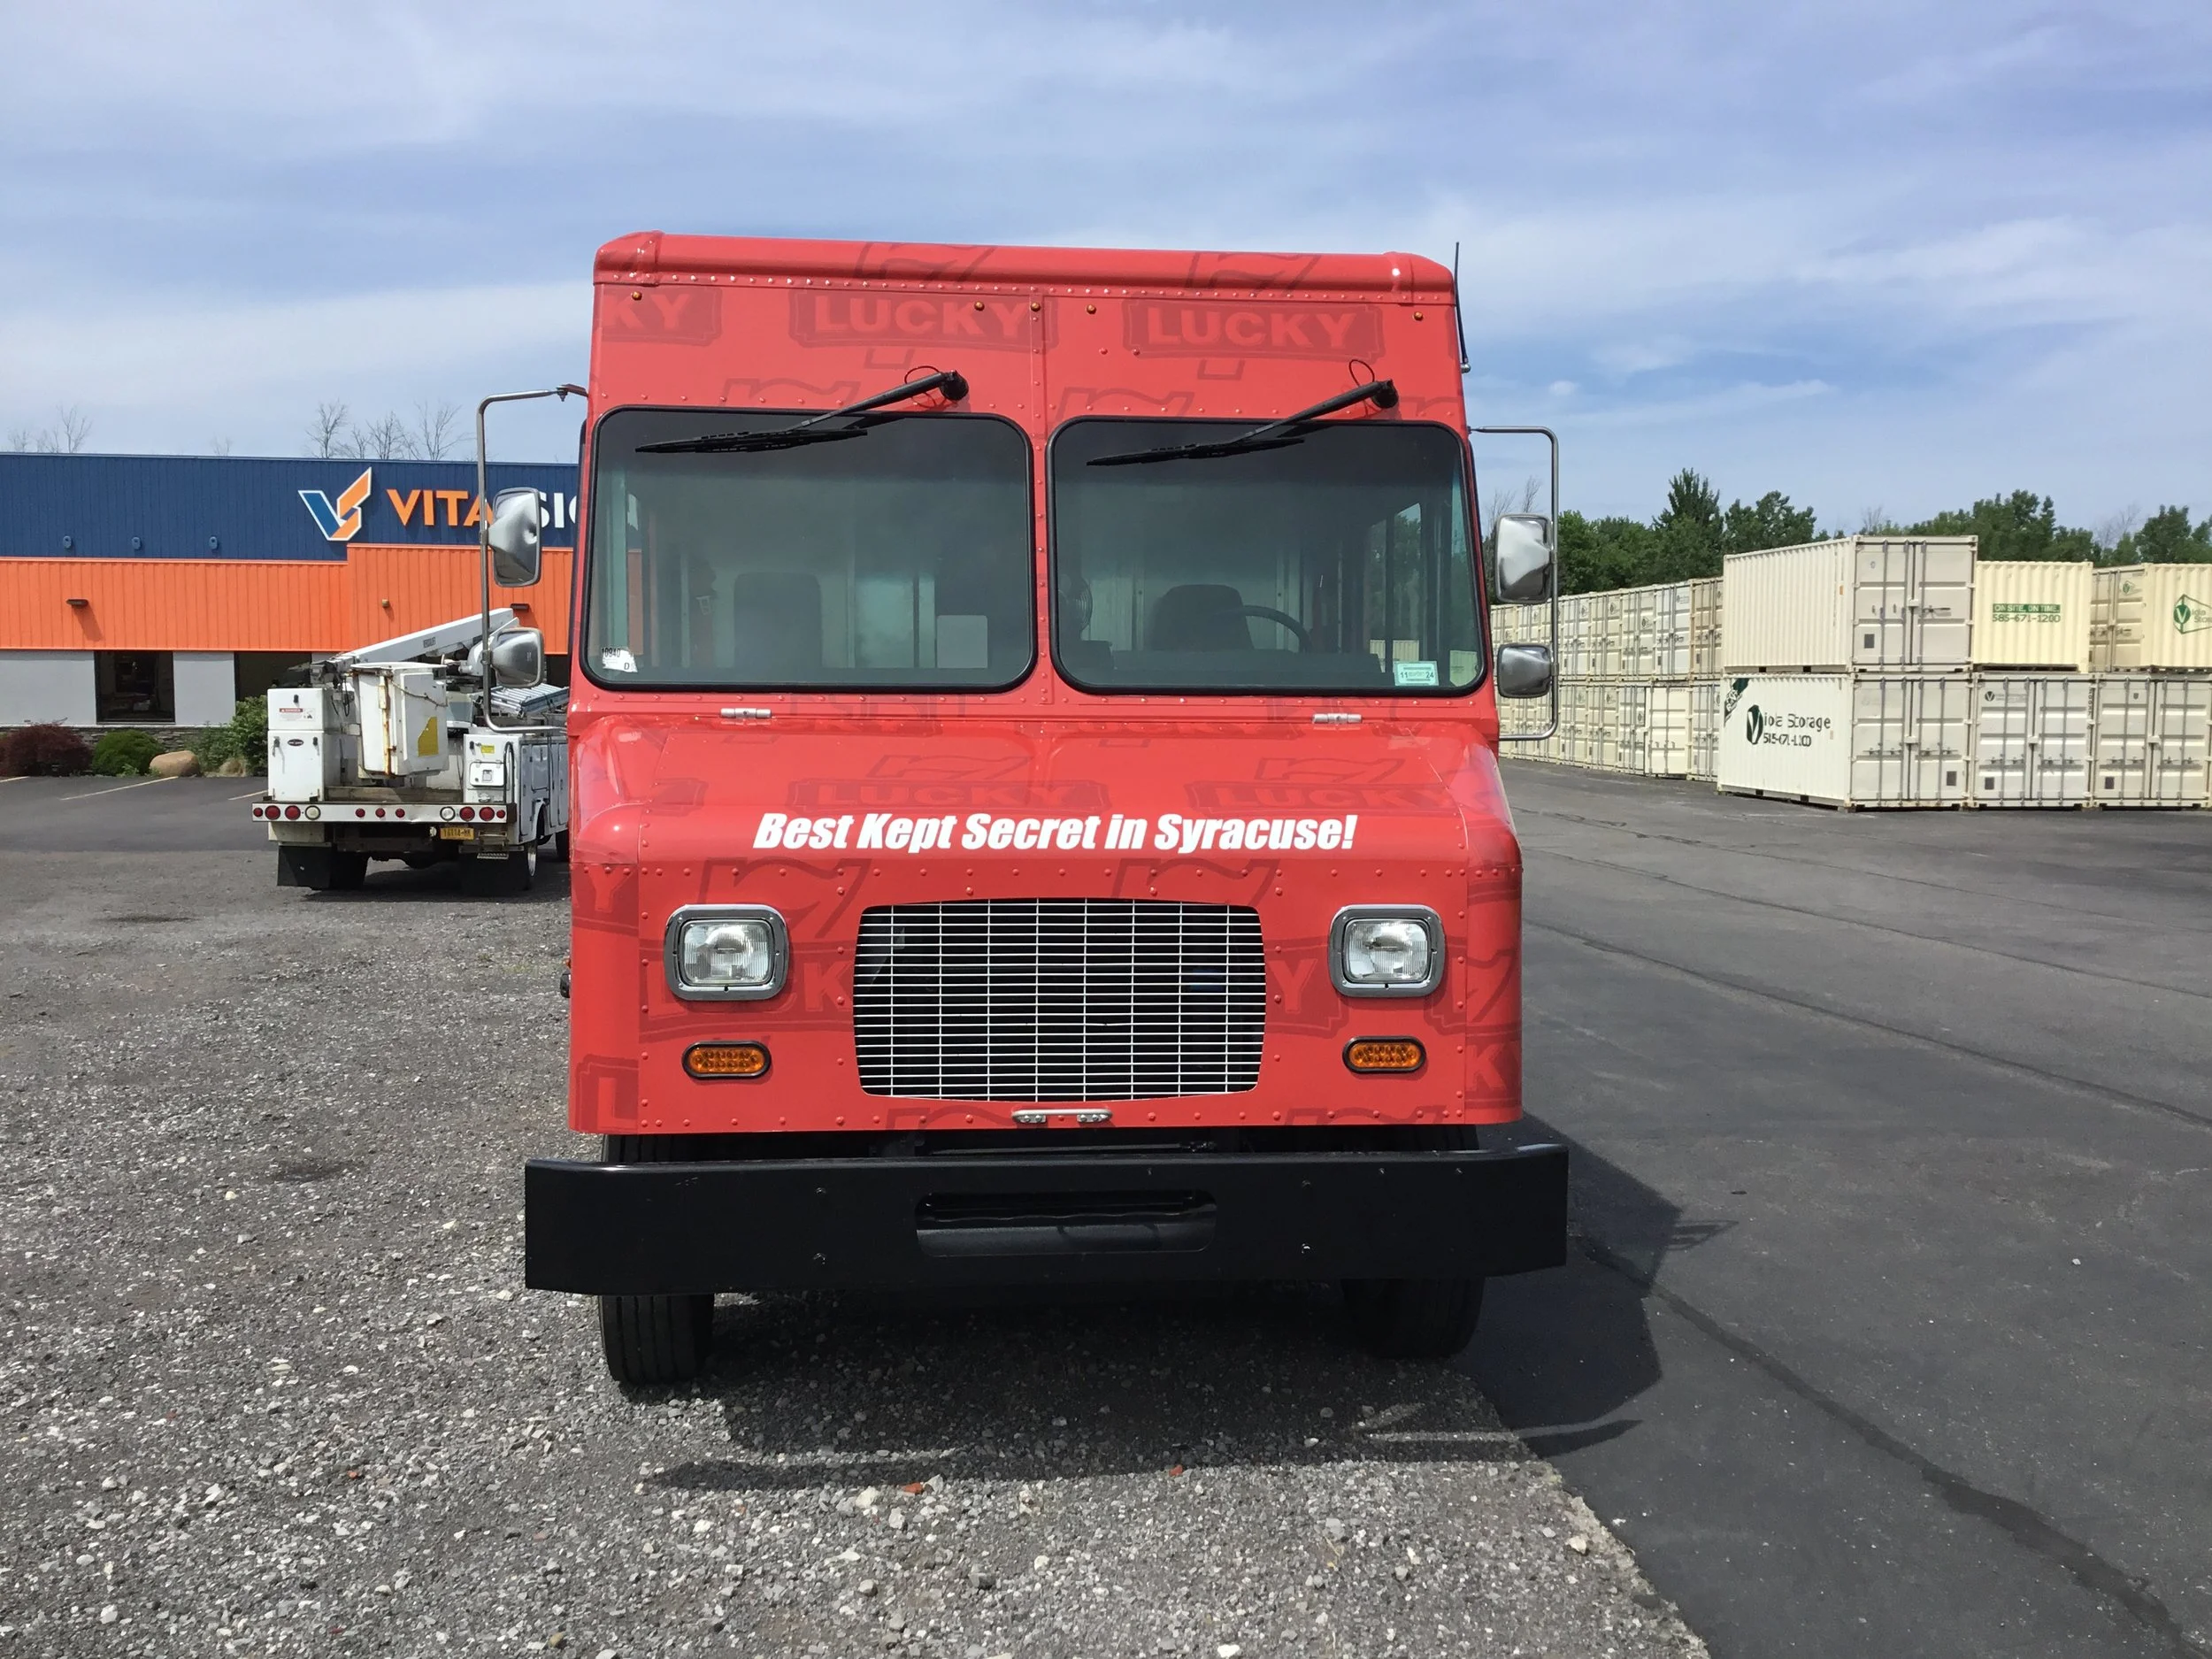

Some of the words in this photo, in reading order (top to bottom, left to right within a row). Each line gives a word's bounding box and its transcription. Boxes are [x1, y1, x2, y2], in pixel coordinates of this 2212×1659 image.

[814, 295, 1029, 335] LUCKY
[1147, 306, 1356, 349] LUCKY
[1992, 614, 2062, 623] 585-671-1200
[753, 813, 854, 849] Best
[856, 813, 957, 853] Kept
[962, 813, 1101, 849] Secret
[1104, 814, 1148, 849] in
[1154, 814, 1358, 854] Syracuse!
